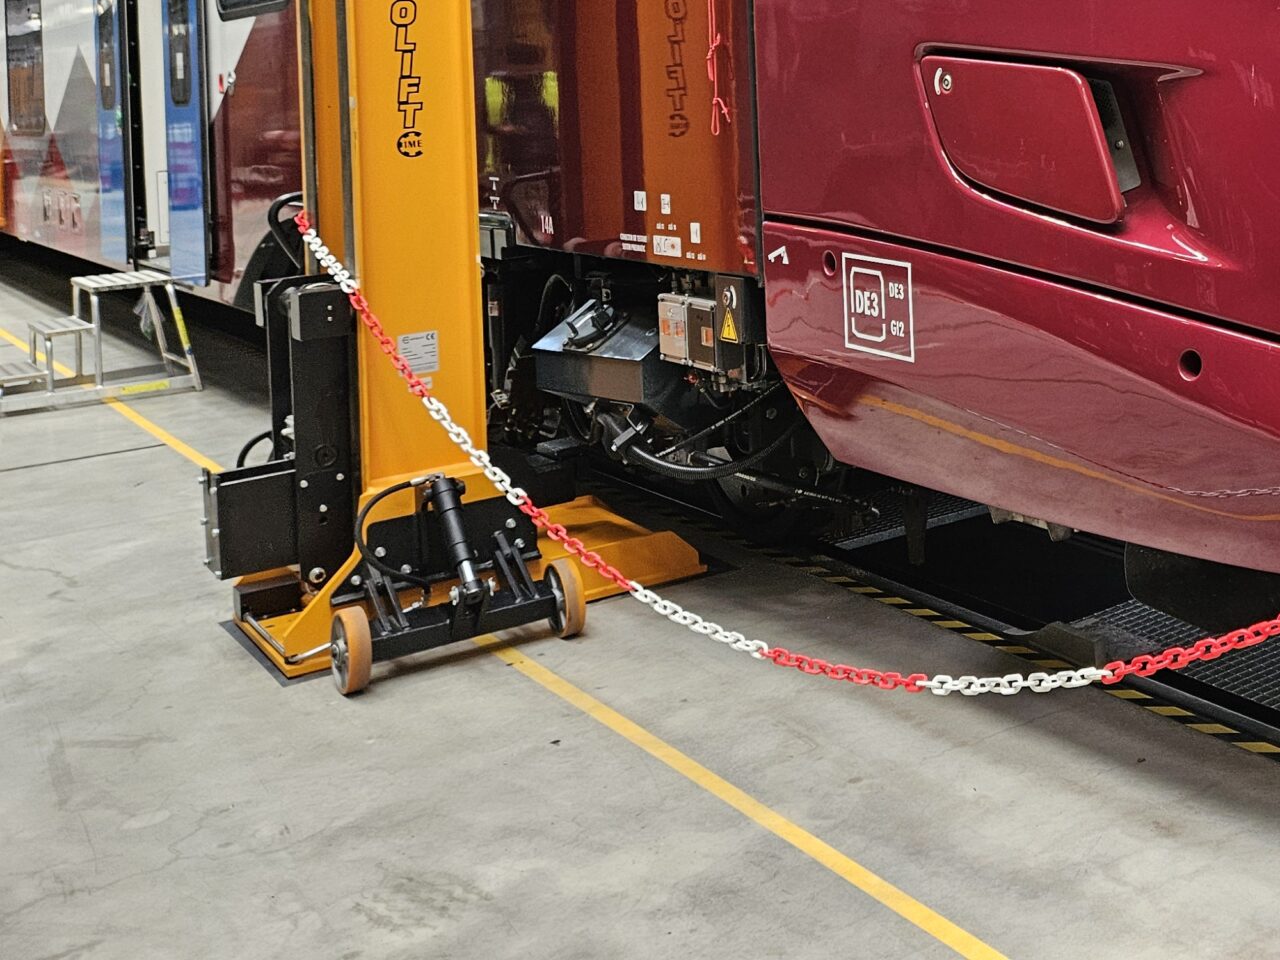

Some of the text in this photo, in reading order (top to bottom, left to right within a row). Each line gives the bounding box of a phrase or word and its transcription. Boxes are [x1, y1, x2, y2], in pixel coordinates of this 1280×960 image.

[541, 215, 553, 234] 14A
[889, 282, 904, 299] DE3
[856, 290, 878, 316] DE3
